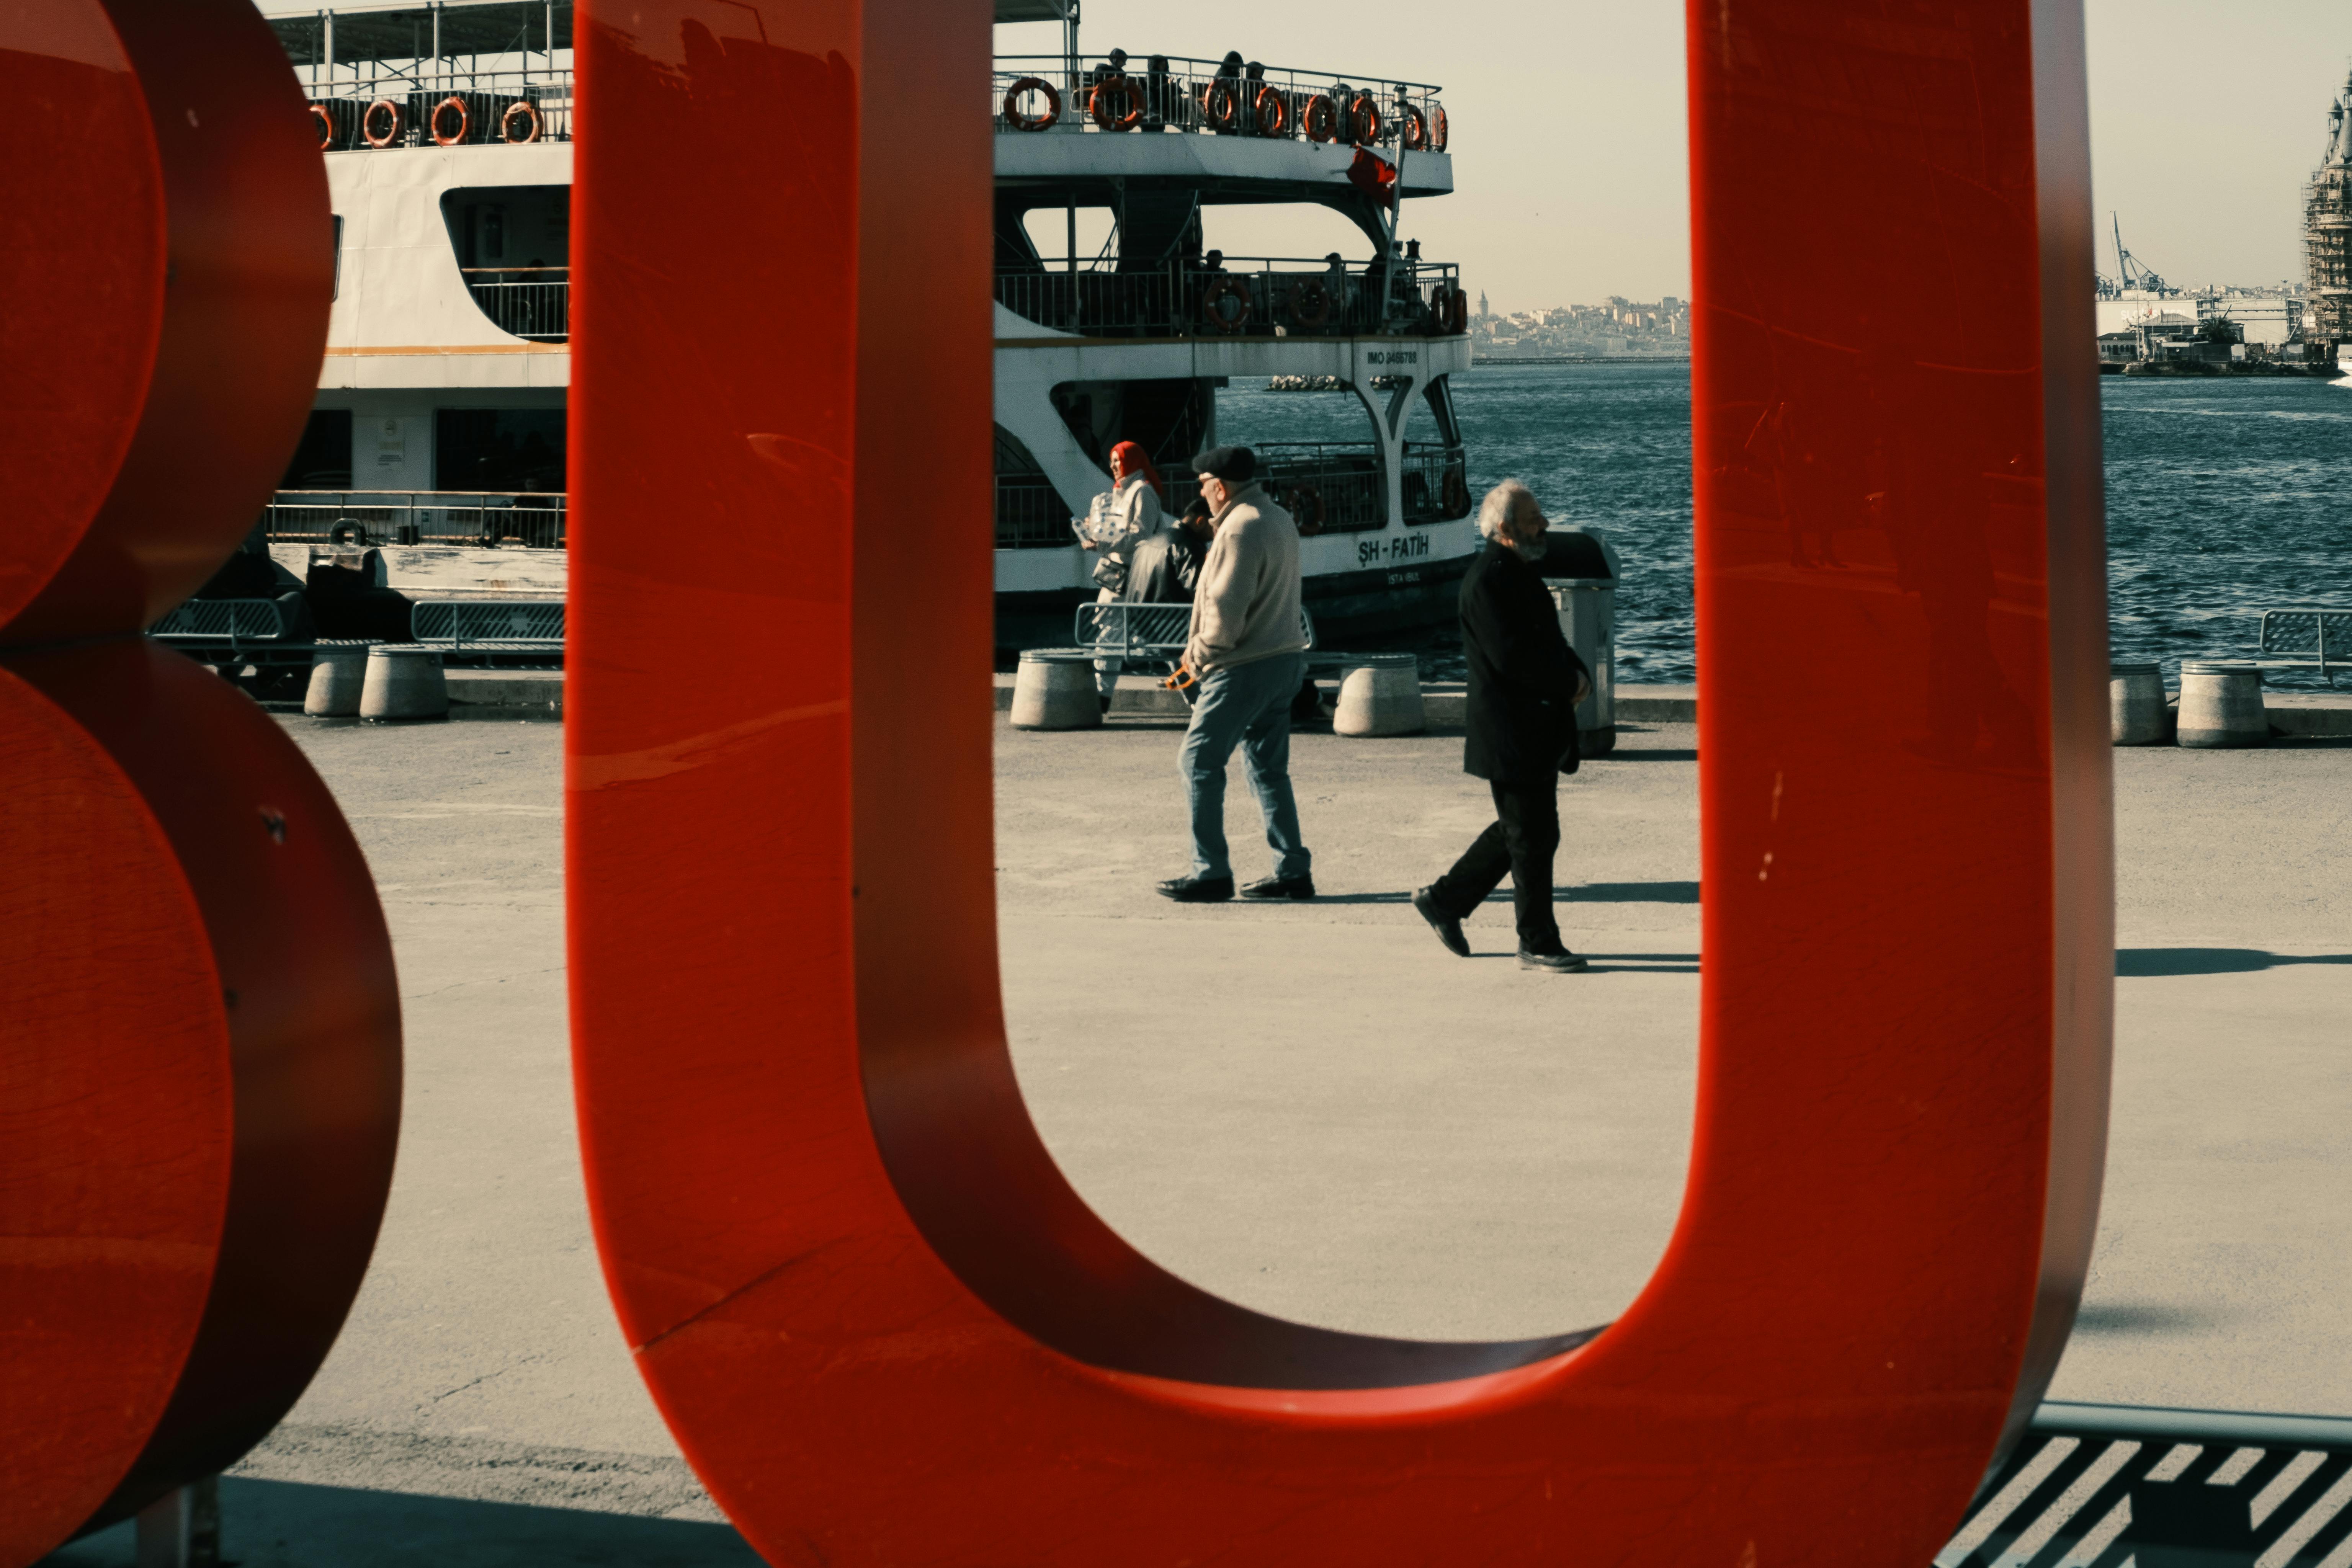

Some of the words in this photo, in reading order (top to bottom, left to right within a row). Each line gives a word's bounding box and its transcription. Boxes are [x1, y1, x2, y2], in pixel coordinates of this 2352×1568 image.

[1368, 351, 1384, 364] IMO
[1359, 541, 1379, 567] ŞH
[1392, 531, 1429, 559] FATİH
